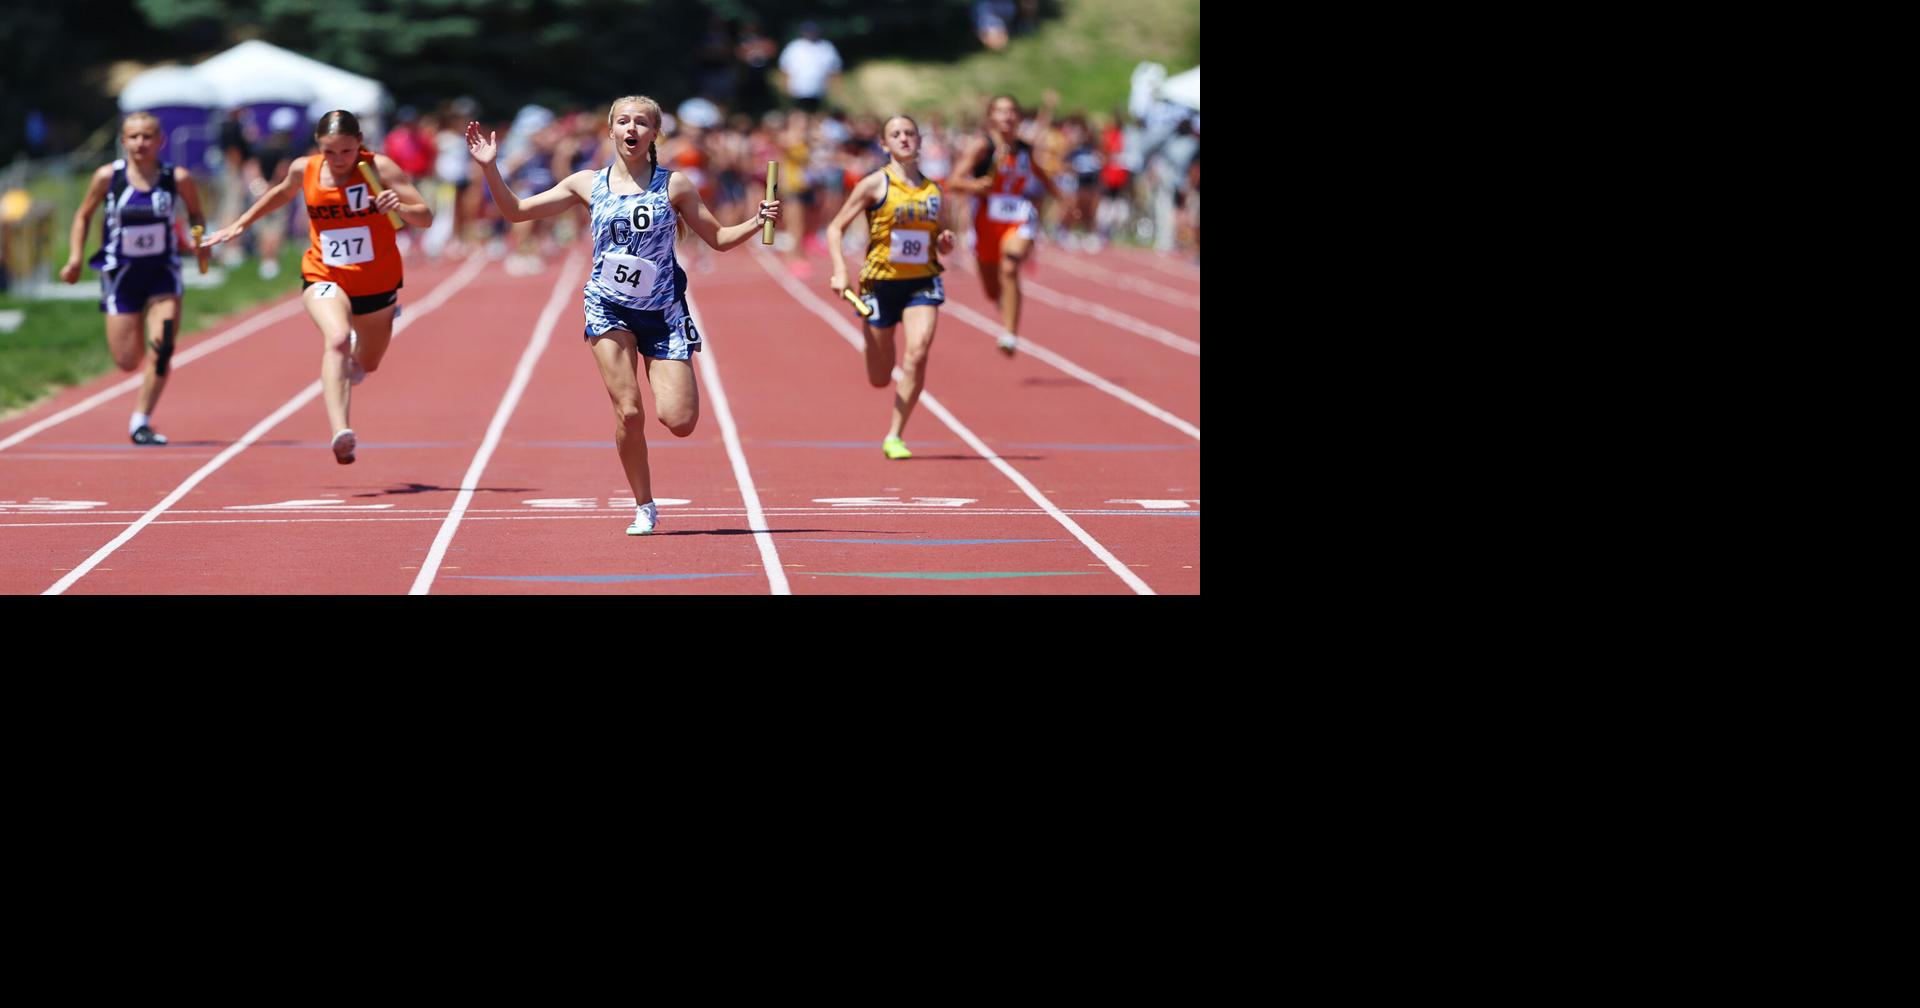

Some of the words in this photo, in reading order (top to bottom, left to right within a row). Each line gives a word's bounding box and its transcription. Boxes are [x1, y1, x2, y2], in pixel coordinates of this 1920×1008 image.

[348, 186, 363, 209] 7
[632, 205, 650, 231] 6
[329, 237, 364, 258] 217
[902, 240, 921, 256] 89
[613, 264, 642, 289] 54
[318, 283, 332, 297] 7
[684, 316, 699, 342] 6
